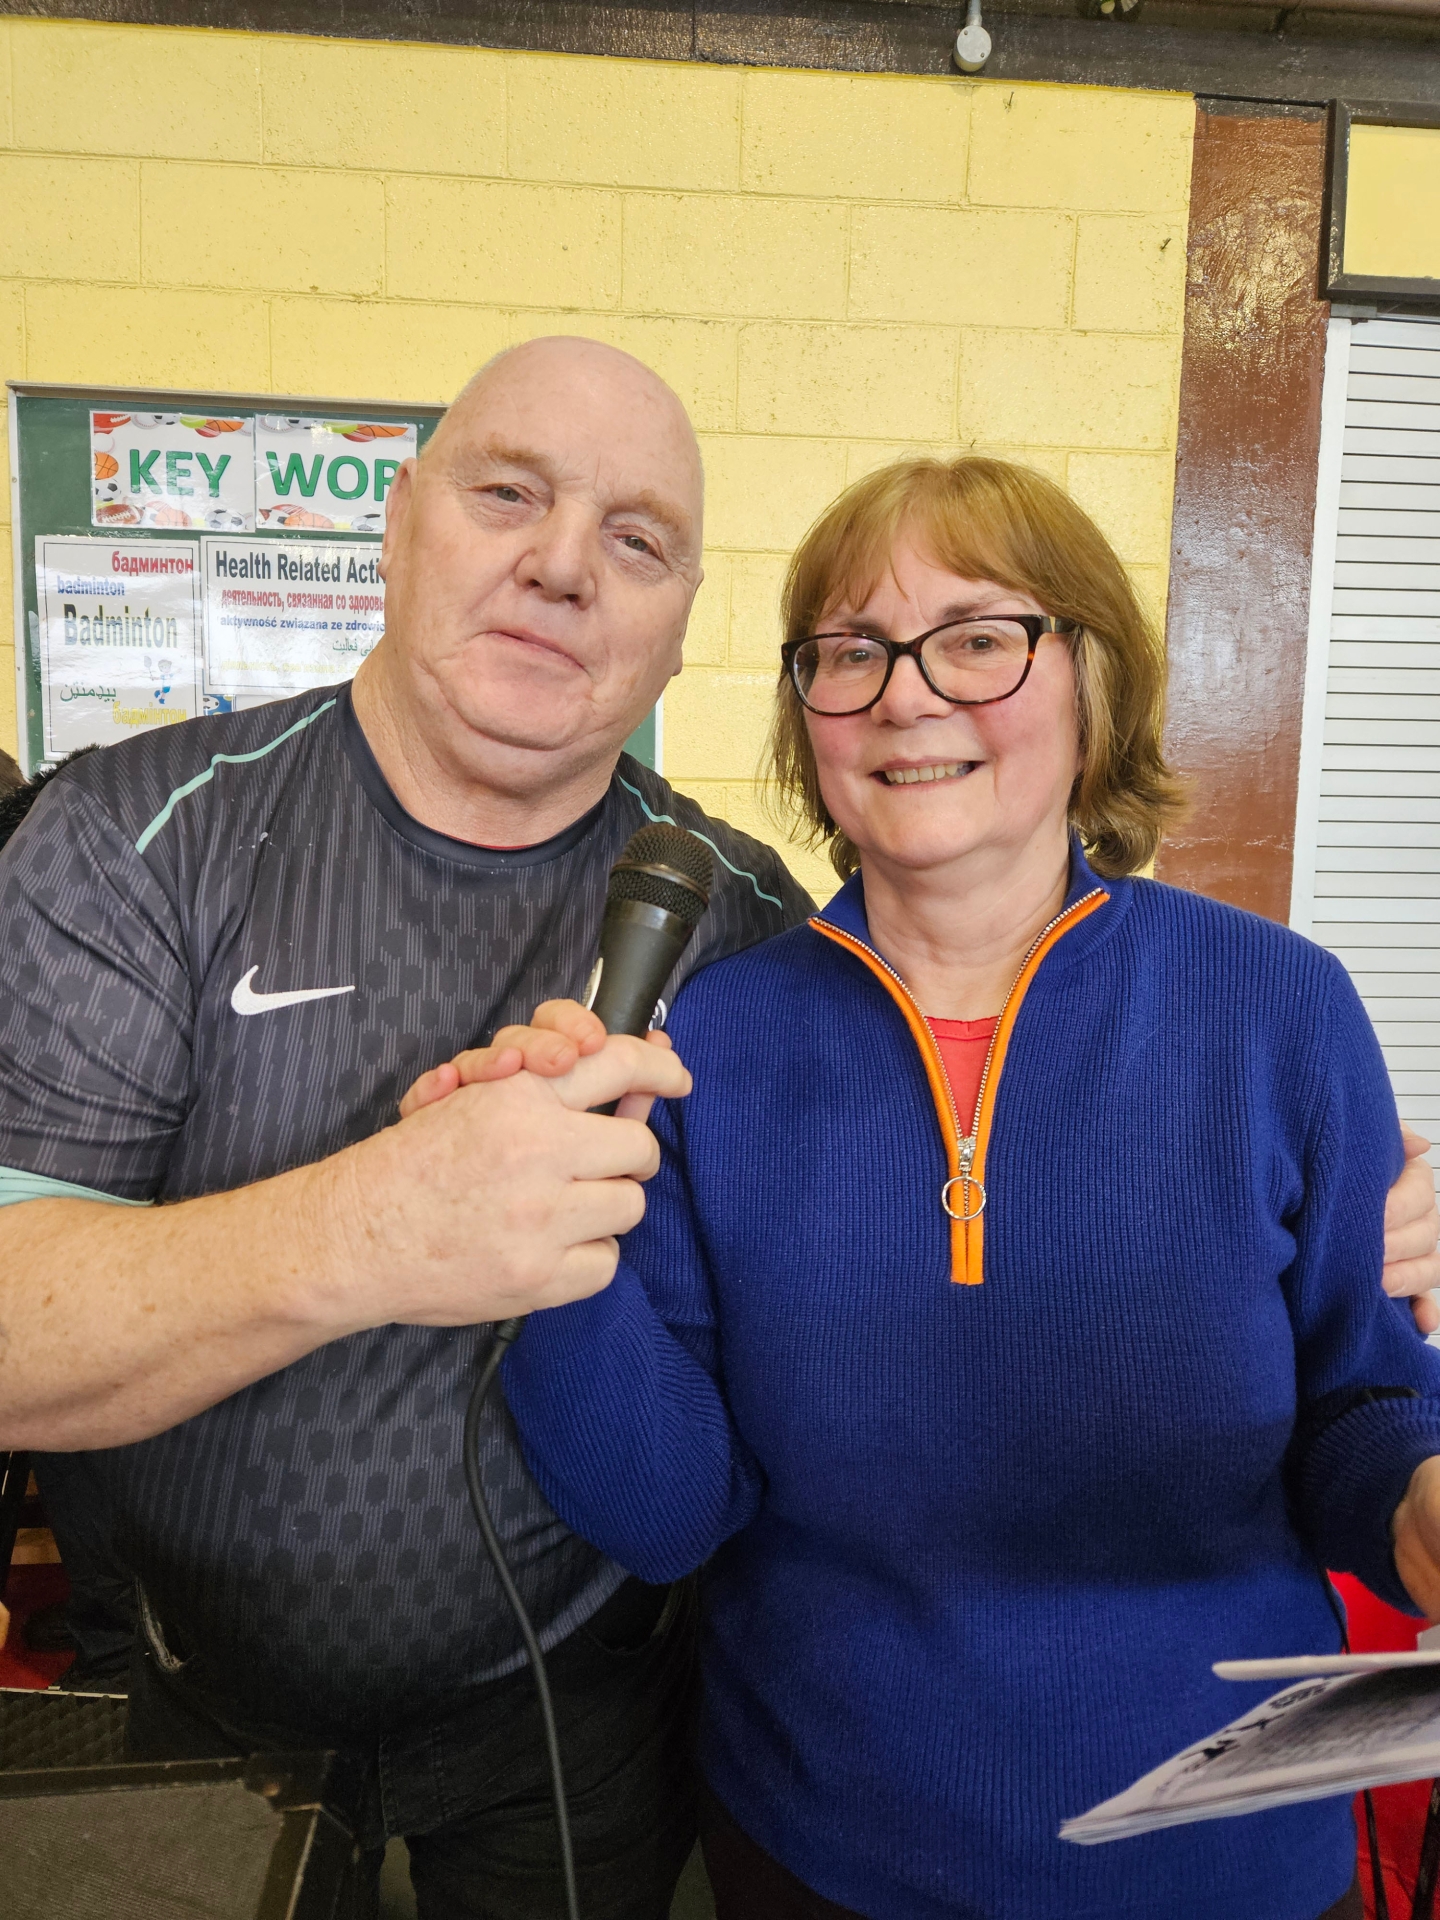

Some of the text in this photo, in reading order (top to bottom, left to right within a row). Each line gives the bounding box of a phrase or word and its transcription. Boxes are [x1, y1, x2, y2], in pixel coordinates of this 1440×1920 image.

[129, 449, 231, 498] KEY
[112, 551, 193, 576] бадминтон
[216, 551, 271, 579] Health
[278, 553, 341, 582] Related
[57, 575, 125, 596] badminton
[287, 592, 334, 610] связанная
[336, 594, 346, 610] со
[349, 594, 385, 616] здоровь
[64, 603, 178, 648] Badminton
[220, 615, 277, 629] aktywność
[280, 617, 328, 632] związana
[331, 620, 342, 630] ze
[112, 701, 187, 728] бадмінтон
